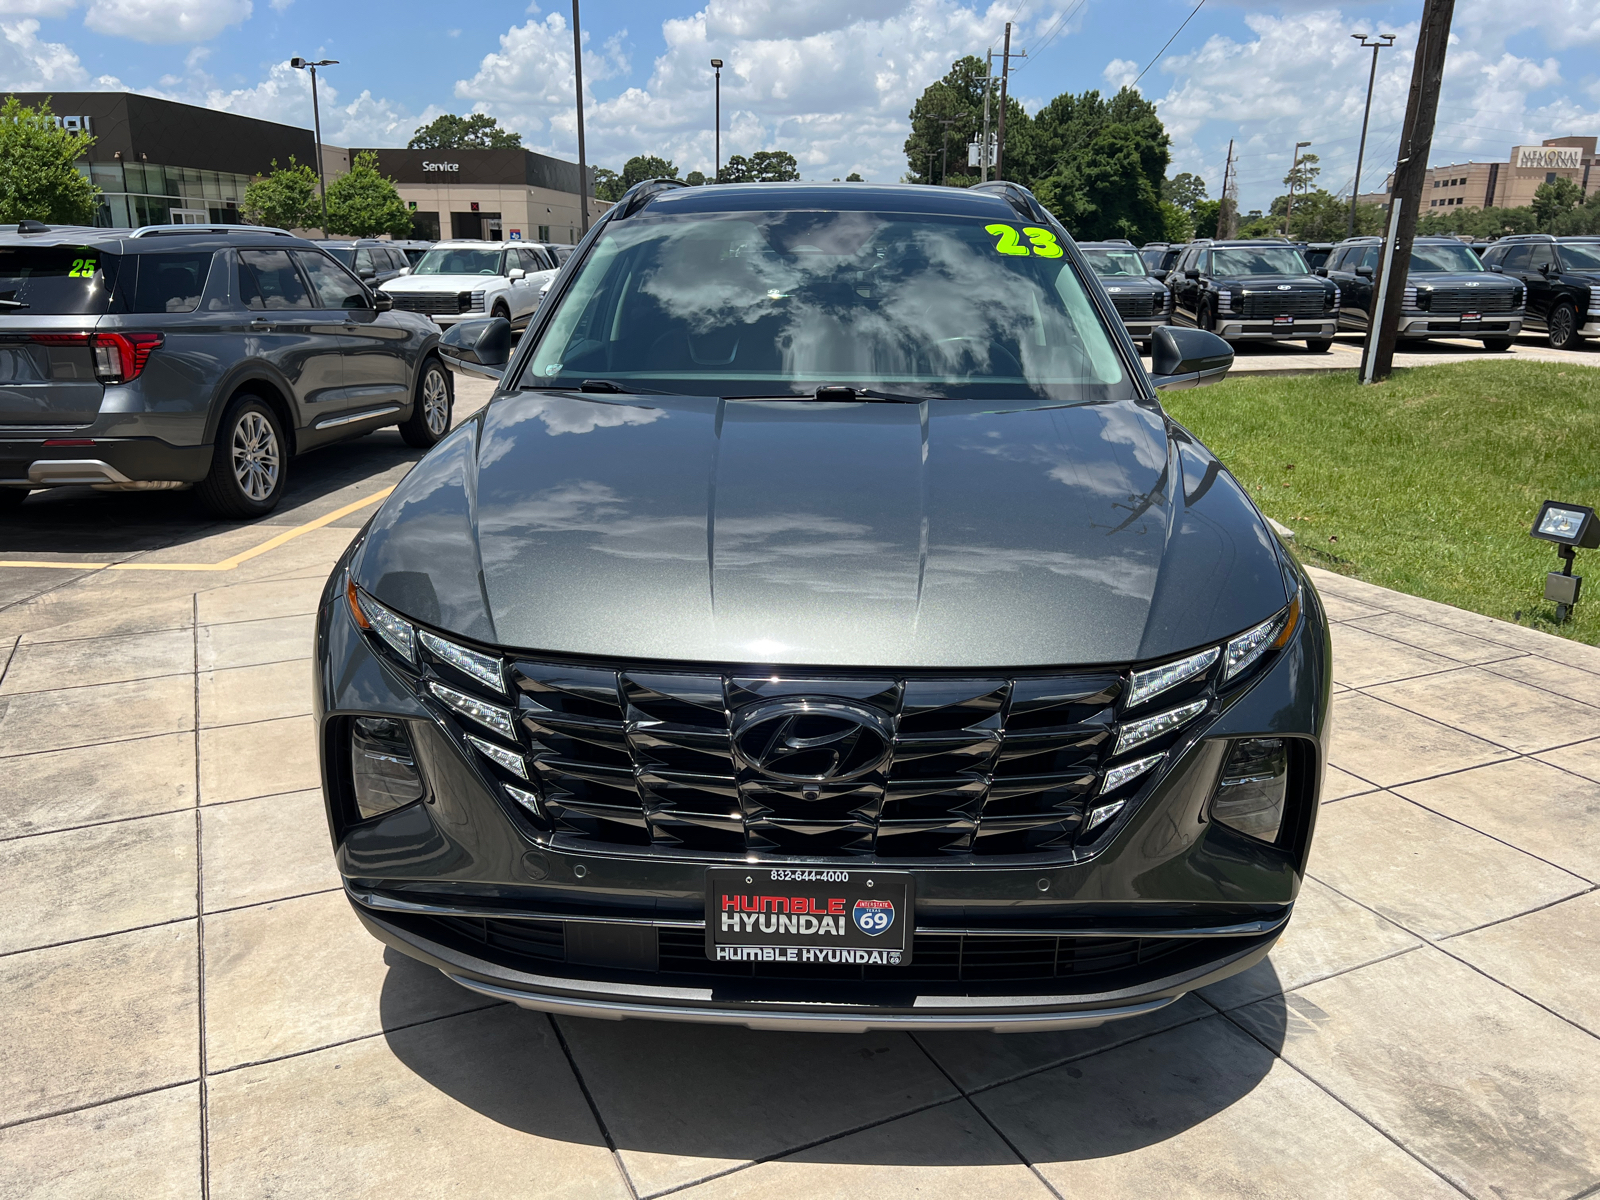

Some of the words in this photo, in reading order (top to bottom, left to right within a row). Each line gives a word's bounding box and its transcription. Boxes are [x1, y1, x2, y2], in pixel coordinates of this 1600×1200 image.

[1520, 159, 1577, 168] HERMANN
[1522, 150, 1578, 160] MEMORIAL
[422, 161, 459, 172] Service
[985, 224, 1063, 258] 23
[68, 259, 97, 278] 25
[770, 870, 849, 882] 832-644-4000
[721, 894, 846, 915] HUMBLE
[721, 912, 846, 936] HYUNDAI
[860, 912, 888, 929] 69
[716, 947, 799, 962] HUMBLE
[802, 949, 887, 965] HYUNDAI
